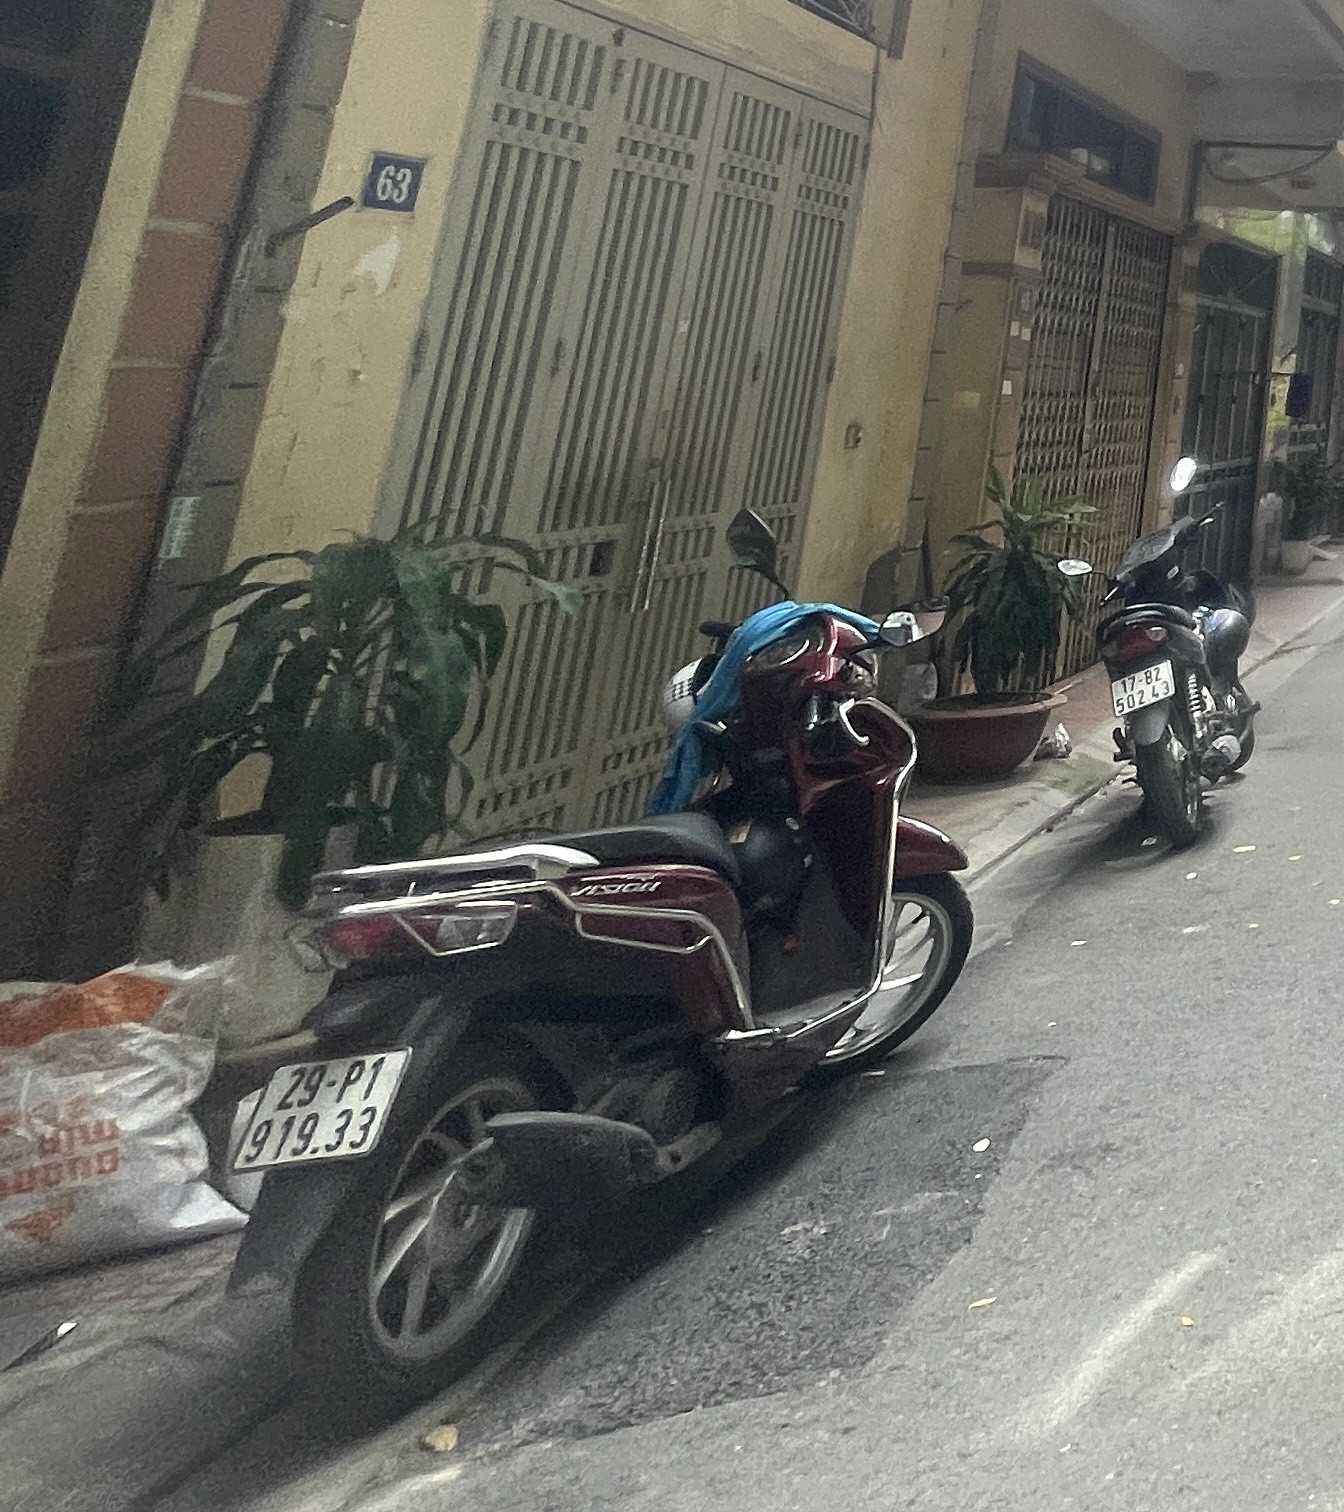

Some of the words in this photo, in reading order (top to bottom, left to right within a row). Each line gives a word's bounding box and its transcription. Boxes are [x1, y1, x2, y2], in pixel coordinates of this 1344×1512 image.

[375, 164, 413, 204] 63
[1120, 667, 1162, 694] 17-B2
[275, 1056, 386, 1111] 29-P1
[244, 1105, 377, 1163] 919.33
